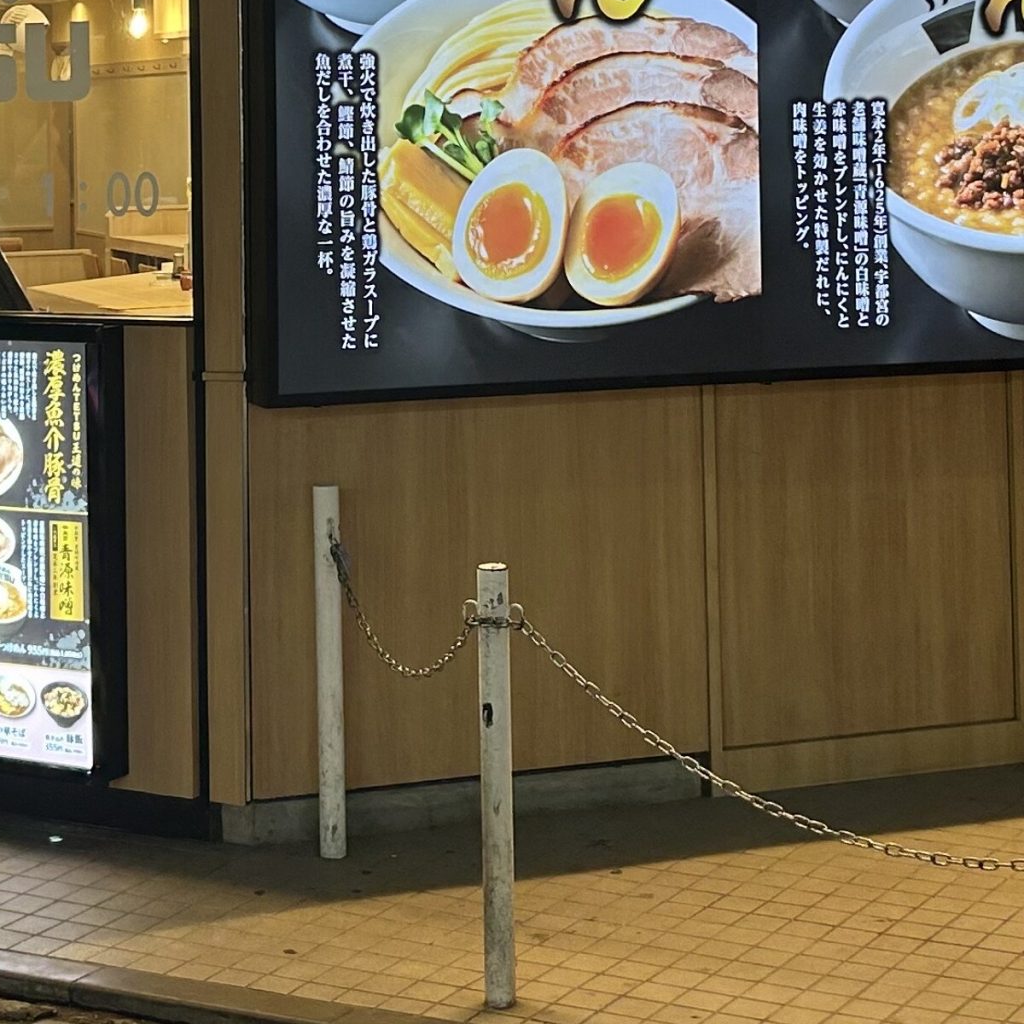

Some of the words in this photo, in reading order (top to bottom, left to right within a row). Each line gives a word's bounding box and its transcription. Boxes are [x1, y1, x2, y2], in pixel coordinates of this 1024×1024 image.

[359, 52, 380, 349] 強火で炊き出した豚骨と鶏ガラスープに
[792, 101, 810, 249] 肉味噌をトッピング。
[43, 349, 67, 504] 濃厚魚介豚骨
